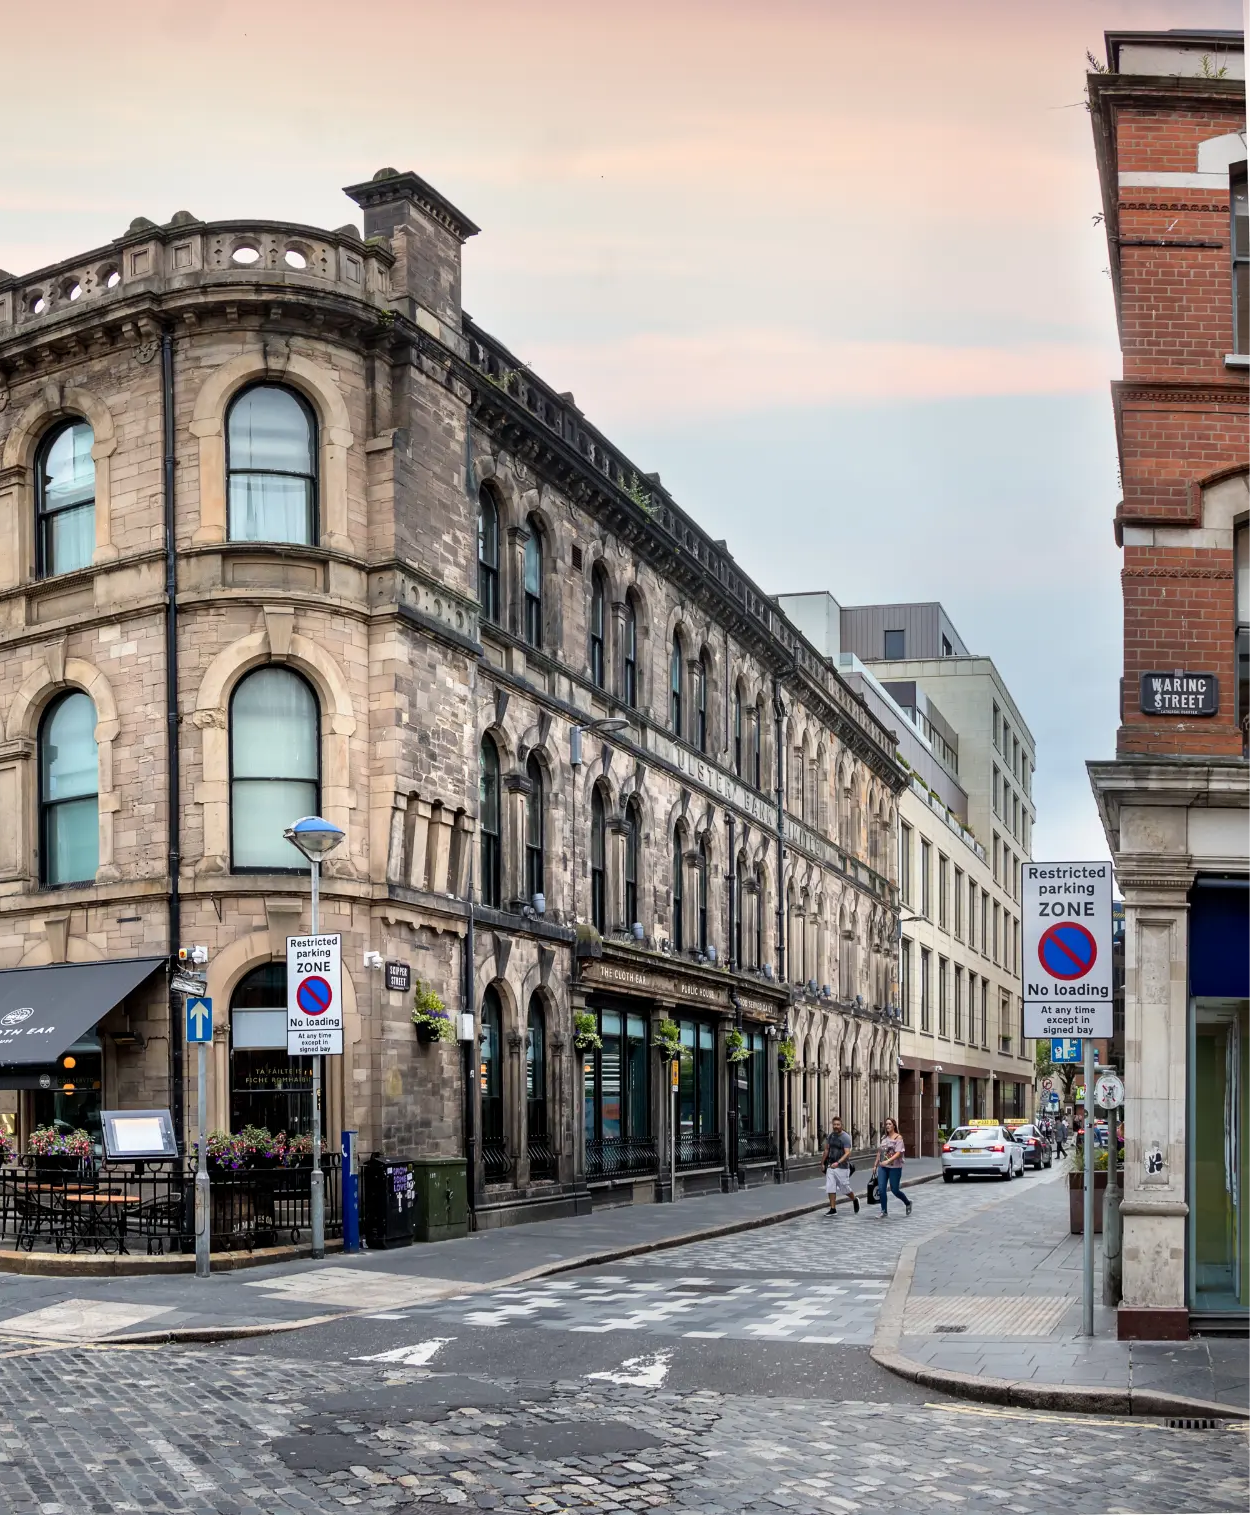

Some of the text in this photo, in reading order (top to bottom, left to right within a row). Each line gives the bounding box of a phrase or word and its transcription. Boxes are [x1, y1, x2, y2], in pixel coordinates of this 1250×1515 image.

[1152, 678, 1206, 692] WARING
[1154, 694, 1204, 708] STREET
[676, 746, 732, 799] ULSTER
[744, 791, 772, 826] BANK
[1029, 866, 1106, 879] Restricted
[1039, 882, 1094, 896] parking
[1038, 902, 1094, 916] ZONE
[290, 937, 337, 947] Restricted
[297, 949, 330, 959] parking
[297, 962, 330, 973] ZONE
[390, 966, 408, 976] SKIPPER
[601, 966, 646, 984] THE CLOTH EAR
[391, 976, 406, 986] STREET
[682, 984, 698, 995] PUBLIC
[1028, 984, 1109, 998] No loading
[1056, 1007, 1071, 1016] any
[290, 1018, 340, 1027] No loading
[1047, 1016, 1078, 1025] except
[1043, 1026, 1094, 1035] signed bay
[394, 1174, 407, 1184] SOME
[394, 1183, 407, 1192] LOVE
